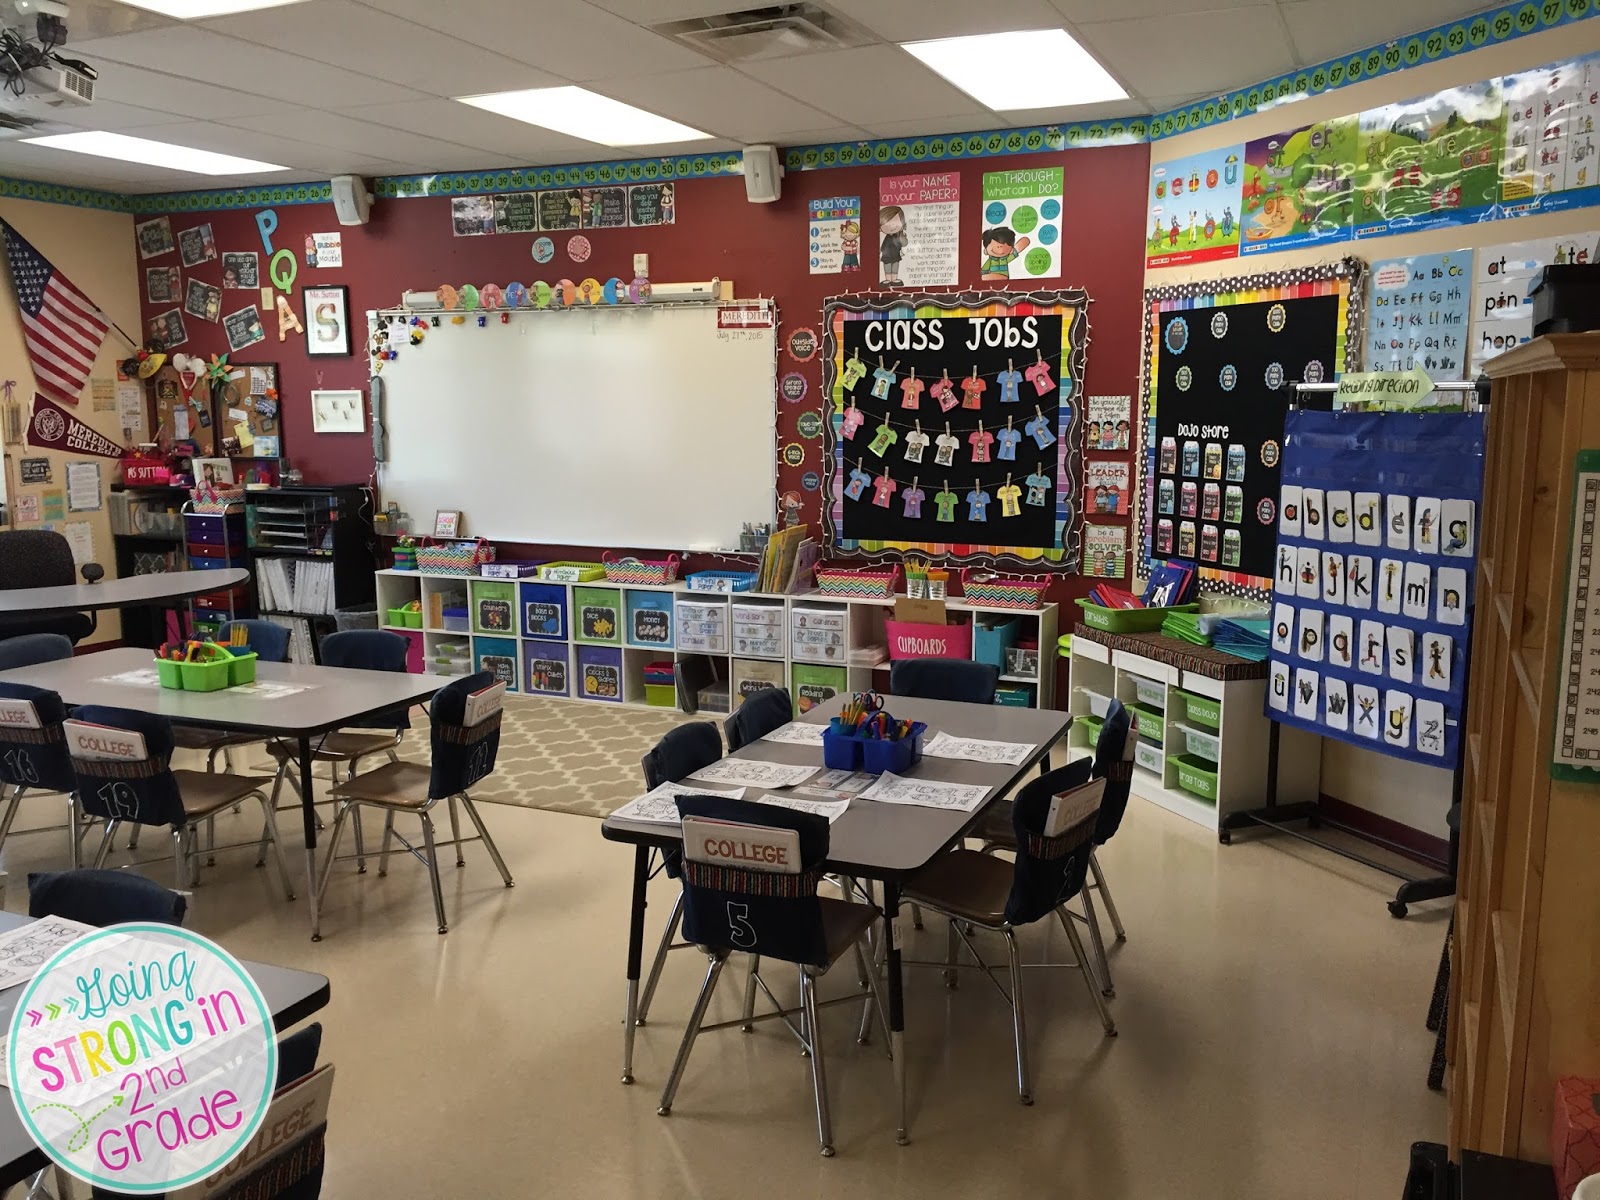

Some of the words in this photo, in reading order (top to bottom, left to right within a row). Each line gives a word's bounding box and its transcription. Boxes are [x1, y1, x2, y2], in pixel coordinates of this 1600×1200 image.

[1152, 124, 1160, 134] 75
[1177, 115, 1186, 126] 77
[1218, 103, 1228, 115] 80
[1249, 94, 1257, 106] 82
[1279, 84, 1290, 96] 84
[1331, 68, 1342, 81] 87
[1349, 62, 1360, 76] 88
[1386, 50, 1399, 64] 90
[1408, 45, 1418, 58] 91
[1427, 38, 1441, 52] 92
[1449, 31, 1463, 46] 93
[1495, 17, 1510, 36] 95
[1520, 10, 1534, 26] 96
[1544, 2, 1560, 19] 97
[824, 153, 834, 161] 58
[841, 151, 852, 160] 59
[858, 150, 870, 158] 60
[896, 146, 906, 156] 62
[932, 144, 943, 153] 64
[989, 139, 1001, 149] 67
[1008, 137, 1020, 147] 68
[1028, 136, 1040, 146] 69
[456, 180, 465, 188] 36
[512, 176, 522, 184] 40
[541, 174, 551, 182] 42
[585, 171, 594, 179] 45
[631, 167, 640, 176] 48
[646, 166, 656, 175] 49
[680, 164, 687, 172] 51
[695, 162, 704, 171] 52
[898, 179, 920, 190] your
[922, 175, 952, 188] NAME
[894, 192, 916, 204] your
[920, 188, 958, 201] PAPER?
[1038, 183, 1058, 194] DO?
[814, 200, 832, 210] Build
[834, 199, 856, 208] Your
[255, 209, 278, 256] P
[270, 249, 298, 294] Q
[1488, 256, 1506, 276] at
[724, 311, 769, 321] MEREDITH
[1485, 292, 1518, 316] pin
[276, 295, 304, 342] A
[316, 303, 340, 342] S
[717, 331, 729, 342] July
[1482, 331, 1516, 350] hop
[67, 418, 122, 454] MEREDITH
[67, 436, 119, 456] COLLEGE
[1088, 536, 1122, 544] problem
[78, 736, 136, 757] COLLEGE
[4, 748, 40, 784] 16
[97, 782, 140, 820] 19
[704, 838, 788, 865] COLLEGE
[727, 900, 758, 948] 5
